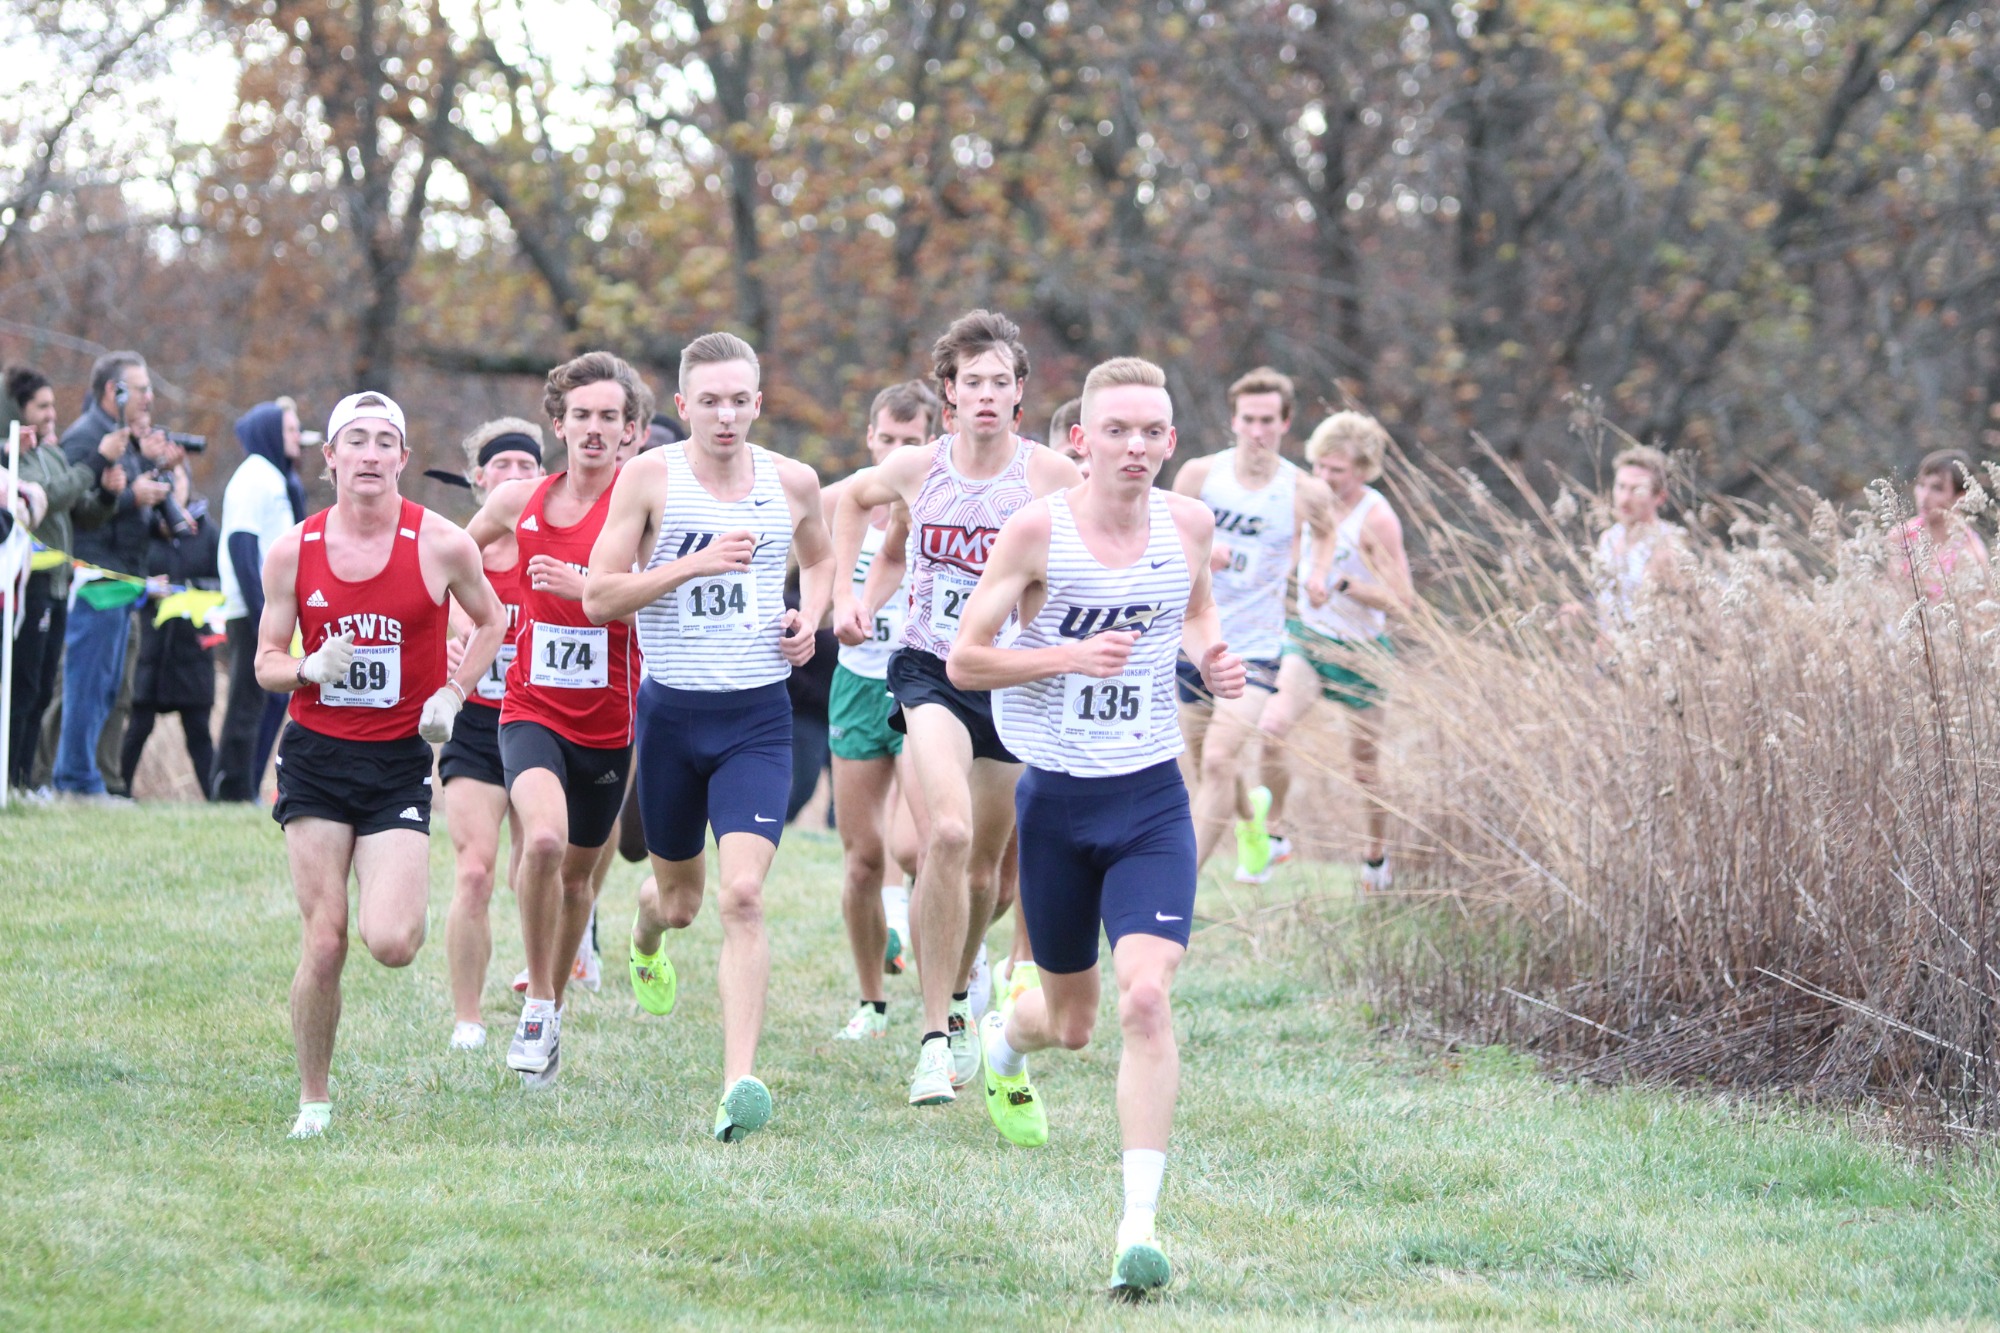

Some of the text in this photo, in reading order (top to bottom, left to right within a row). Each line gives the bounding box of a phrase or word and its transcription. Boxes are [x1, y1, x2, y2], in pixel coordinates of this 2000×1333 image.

[690, 583, 746, 616] 134
[323, 613, 402, 643] LEWIS
[546, 640, 593, 671] 174
[333, 661, 386, 690] 69
[1078, 685, 1141, 721] 135
